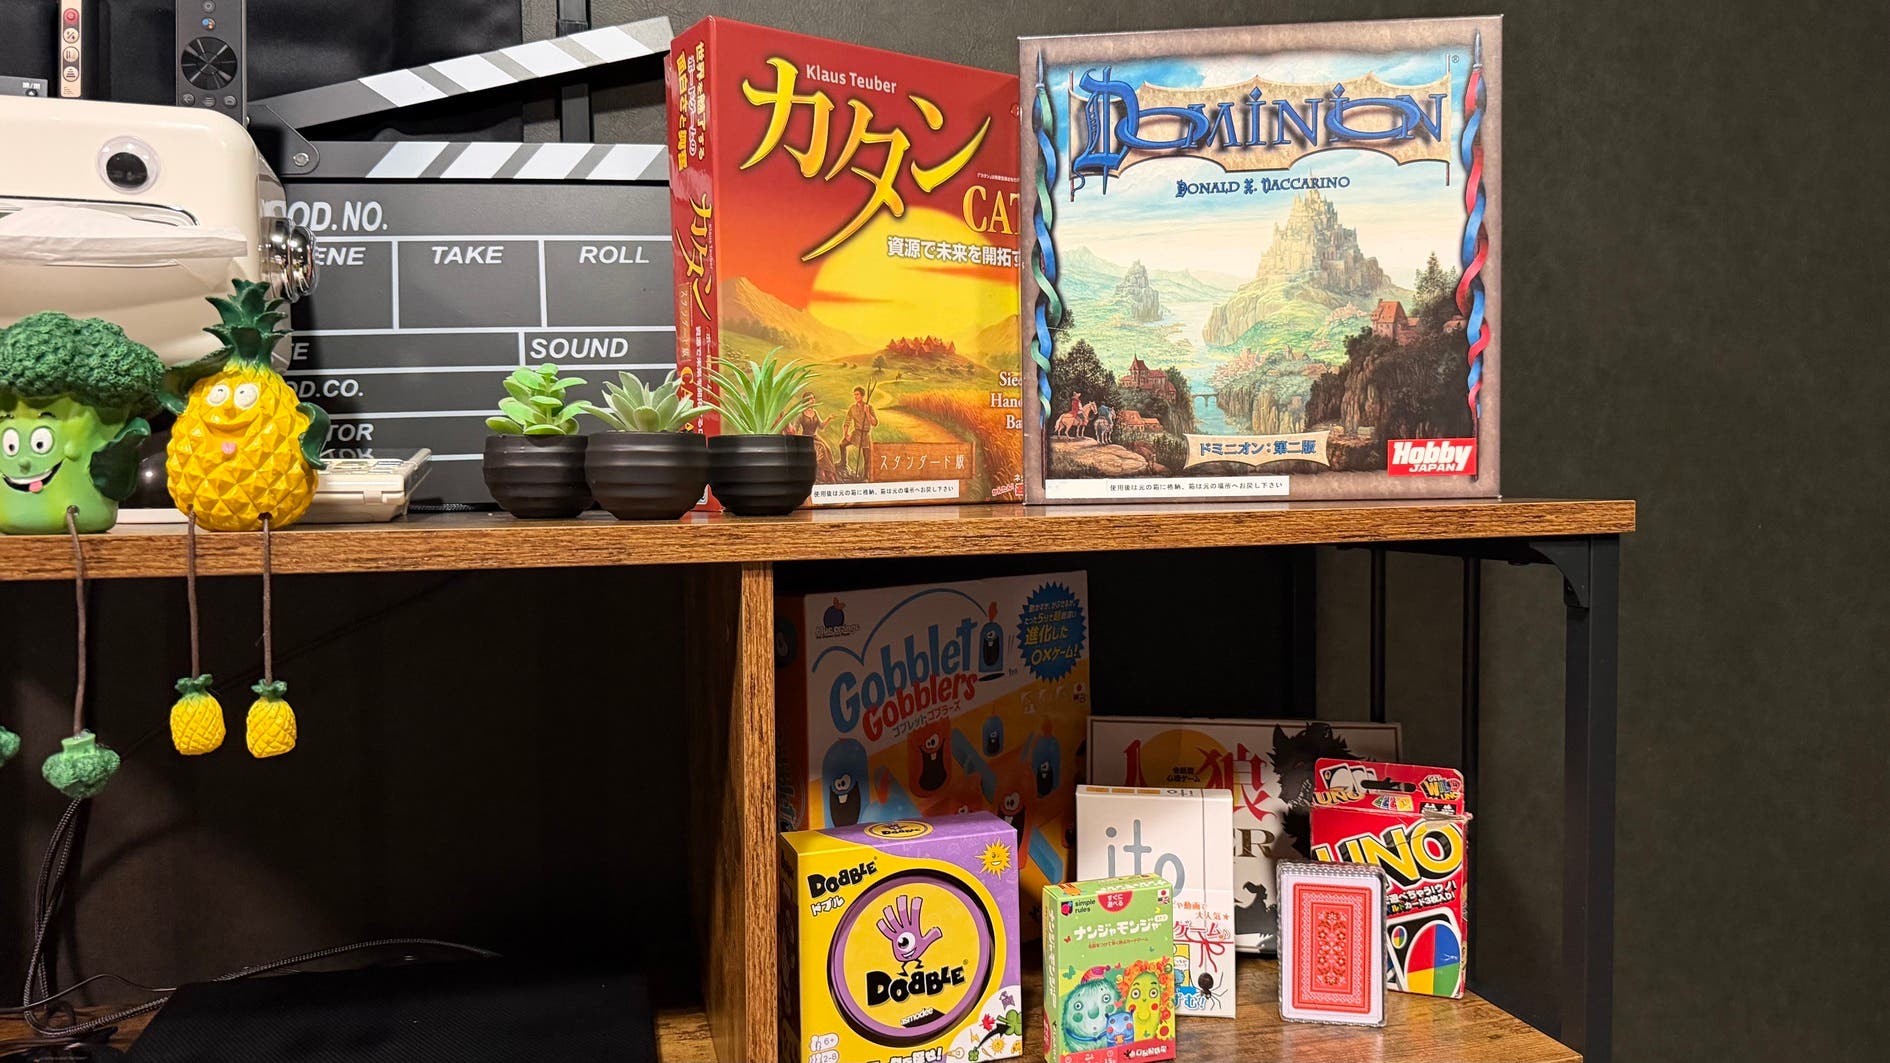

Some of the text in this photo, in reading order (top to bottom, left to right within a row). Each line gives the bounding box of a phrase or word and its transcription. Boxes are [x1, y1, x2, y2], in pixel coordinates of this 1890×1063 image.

[806, 64, 897, 95] Klaus Teuber
[739, 57, 991, 262] カタン
[1175, 179, 1240, 198] DONALD
[1261, 176, 1350, 194] VACCARINO
[314, 248, 366, 266] ENE
[432, 246, 504, 265] TAKE
[579, 246, 650, 264] ROLL
[676, 193, 712, 321] カタン
[530, 338, 629, 359] SOUND
[880, 455, 965, 471] スタンダード版
[1392, 442, 1473, 472] Hobby
[1408, 461, 1457, 473] JAPAN
[829, 617, 978, 733] Gobblet
[862, 673, 978, 742] Gobblers
[1313, 789, 1365, 805] UNO
[1104, 819, 1186, 898] ito
[811, 895, 845, 917] ドブル
[1075, 899, 1096, 907] simple
[1107, 900, 1124, 908] 遊べる
[1074, 917, 1162, 940] ナンジャモンジャ
[823, 1037, 835, 1046] 6+
[823, 1053, 837, 1063] 2-8
